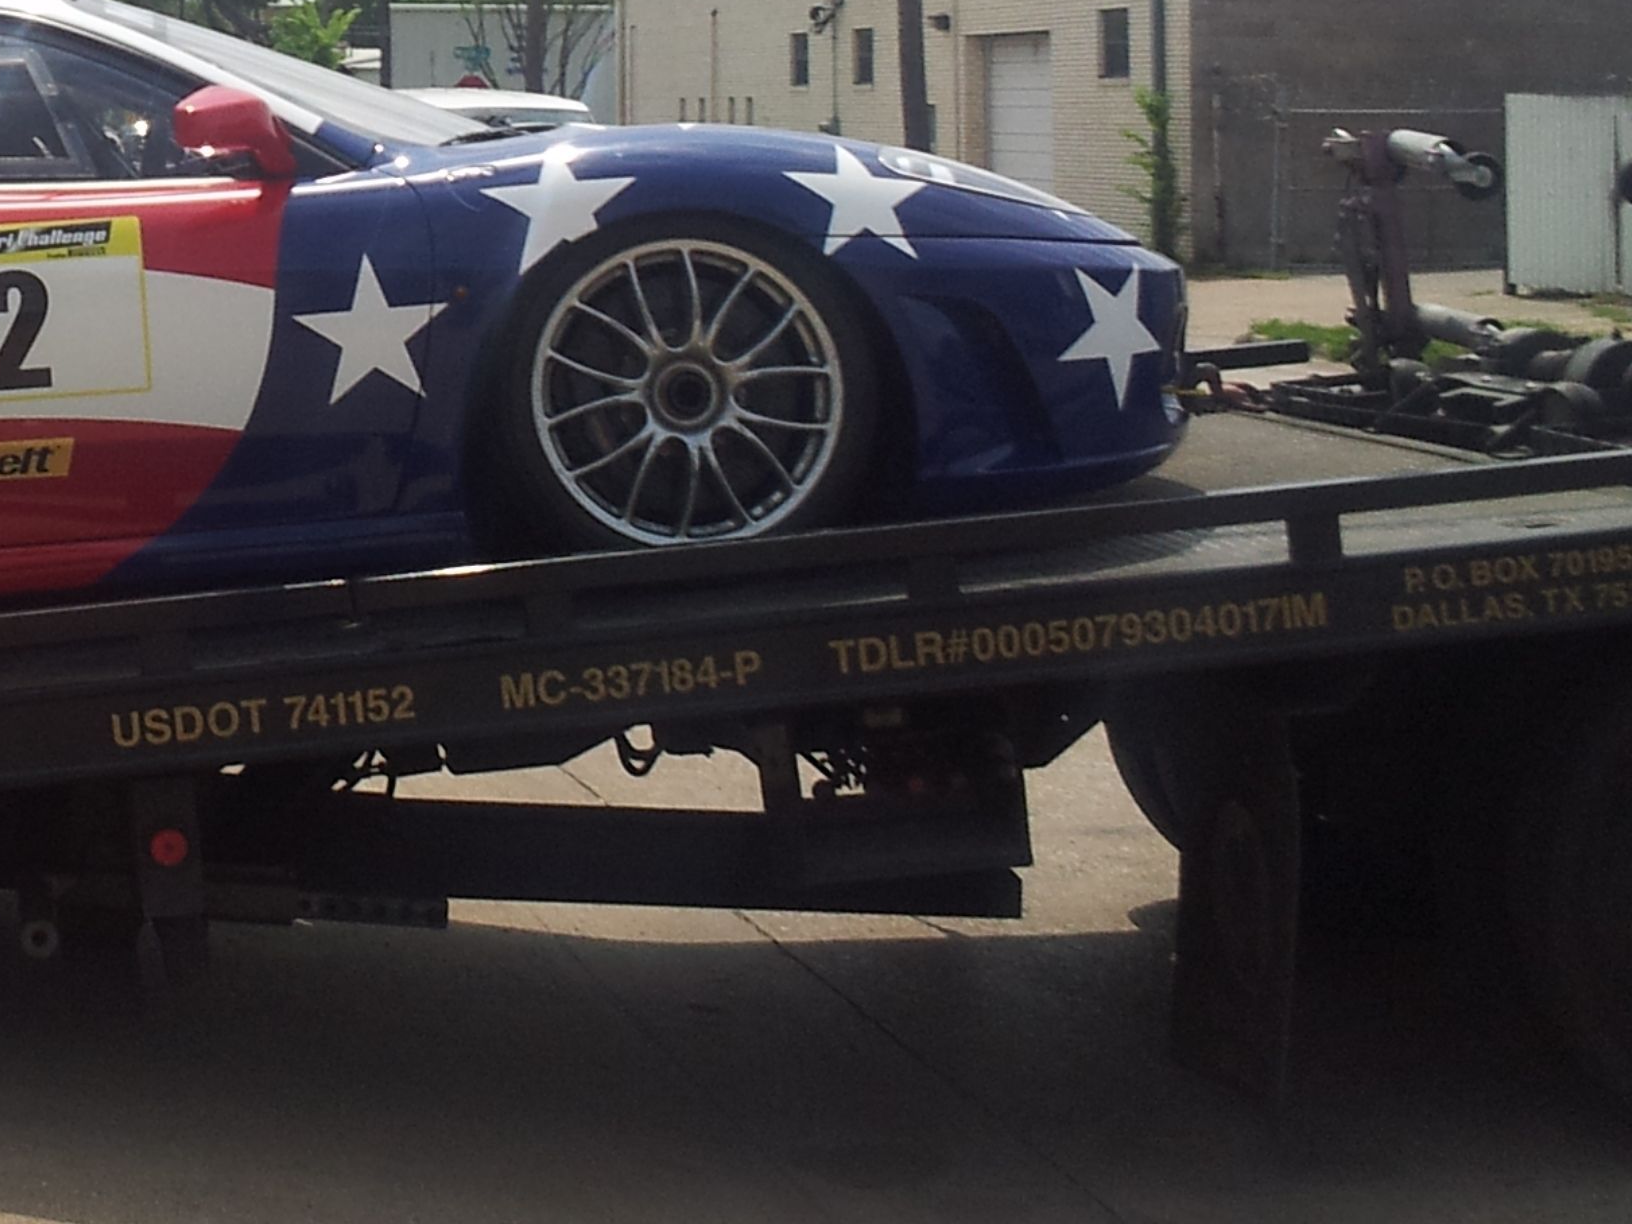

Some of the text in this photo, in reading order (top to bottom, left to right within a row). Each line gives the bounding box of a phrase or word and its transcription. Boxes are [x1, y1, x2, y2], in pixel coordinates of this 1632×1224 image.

[16, 227, 107, 250] Challenge
[1470, 556, 1539, 587] BOX
[1542, 585, 1584, 613] TX
[110, 696, 268, 748] USDOT
[284, 687, 416, 729] 741152
[500, 650, 762, 711] MC-337184-P
